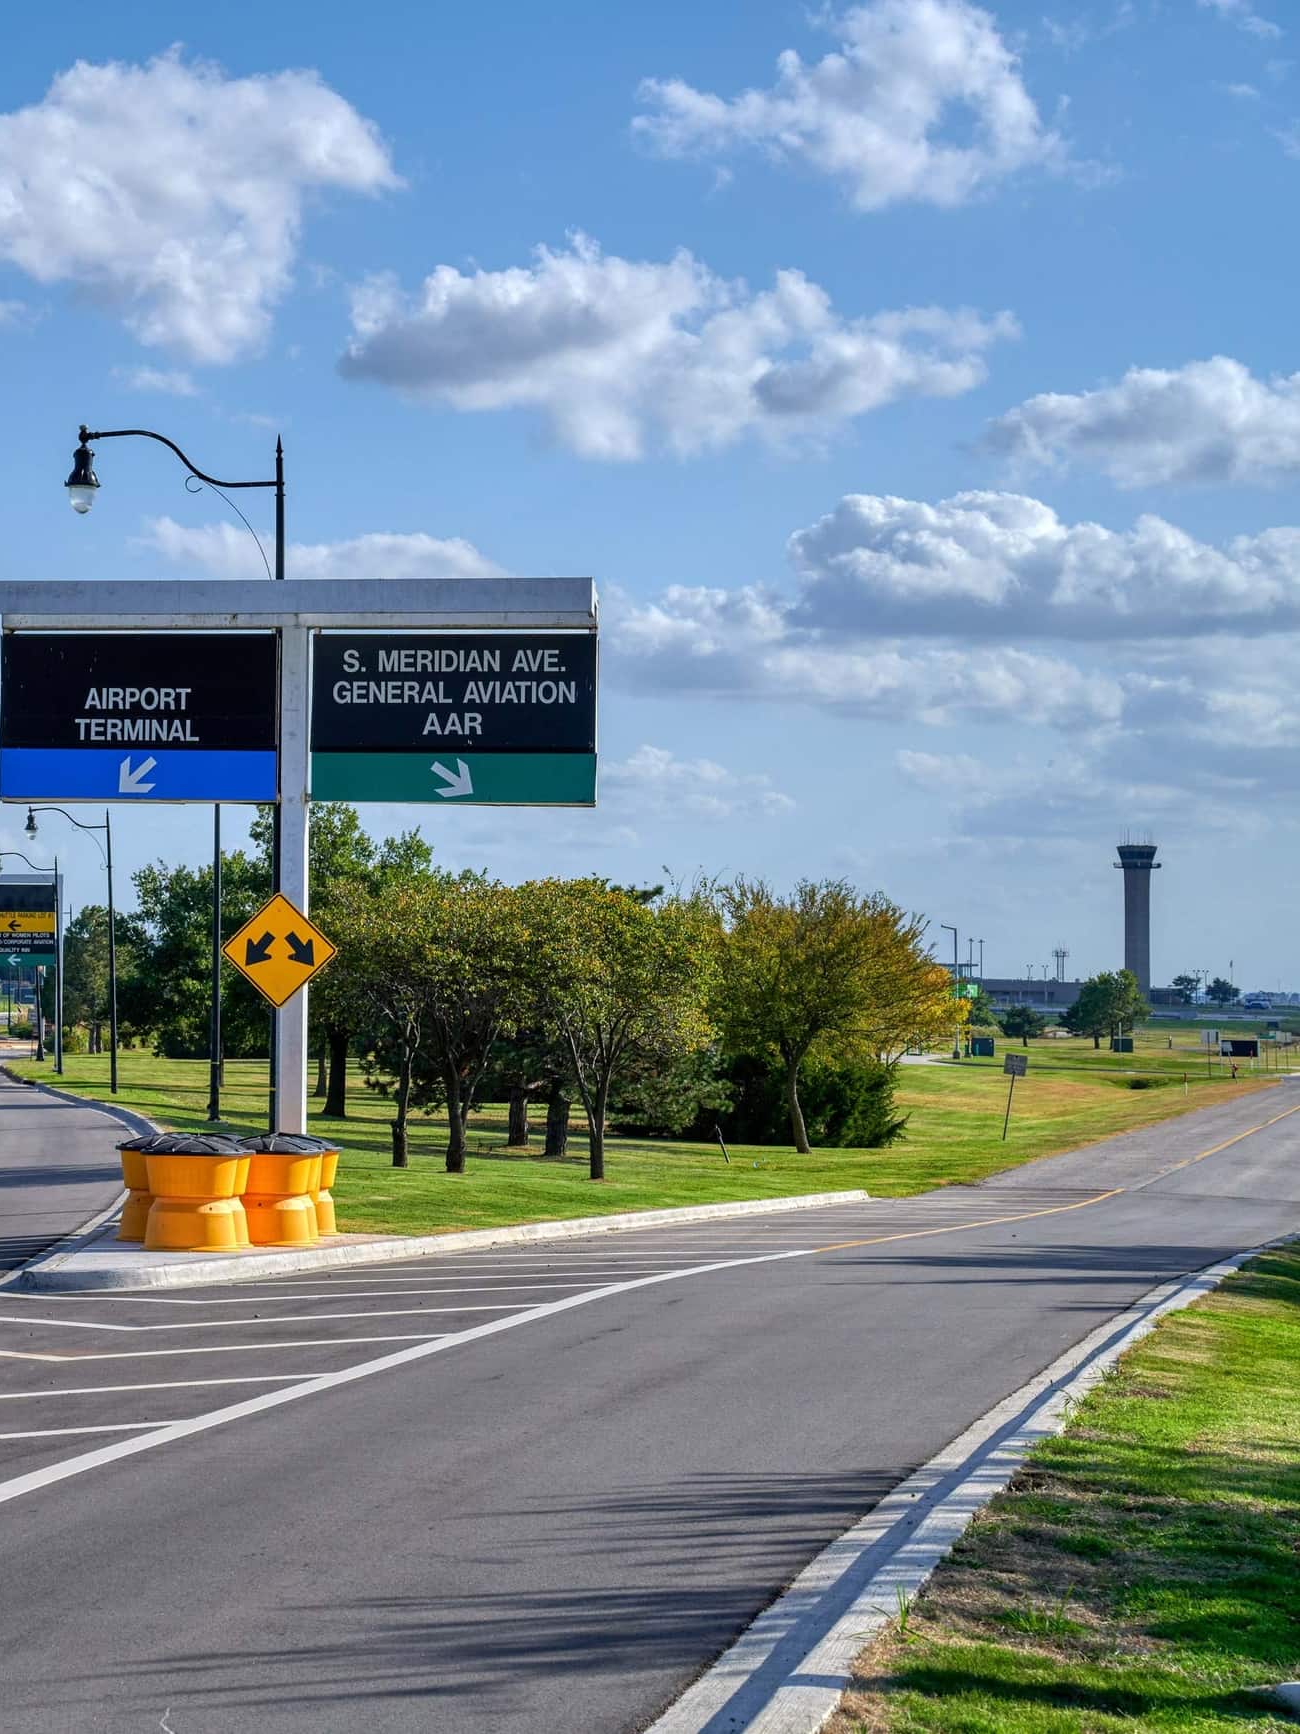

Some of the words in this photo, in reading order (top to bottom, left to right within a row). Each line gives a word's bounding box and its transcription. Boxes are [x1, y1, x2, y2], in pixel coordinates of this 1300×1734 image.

[343, 649, 367, 673] S.
[378, 649, 501, 673] MERIDIAN
[511, 649, 566, 673] AVE.
[84, 687, 191, 711] AIRPORT
[332, 680, 453, 704] GENERAL
[463, 680, 576, 704] AVIATION
[74, 718, 200, 742] TERMINAL
[422, 712, 483, 736] AAR
